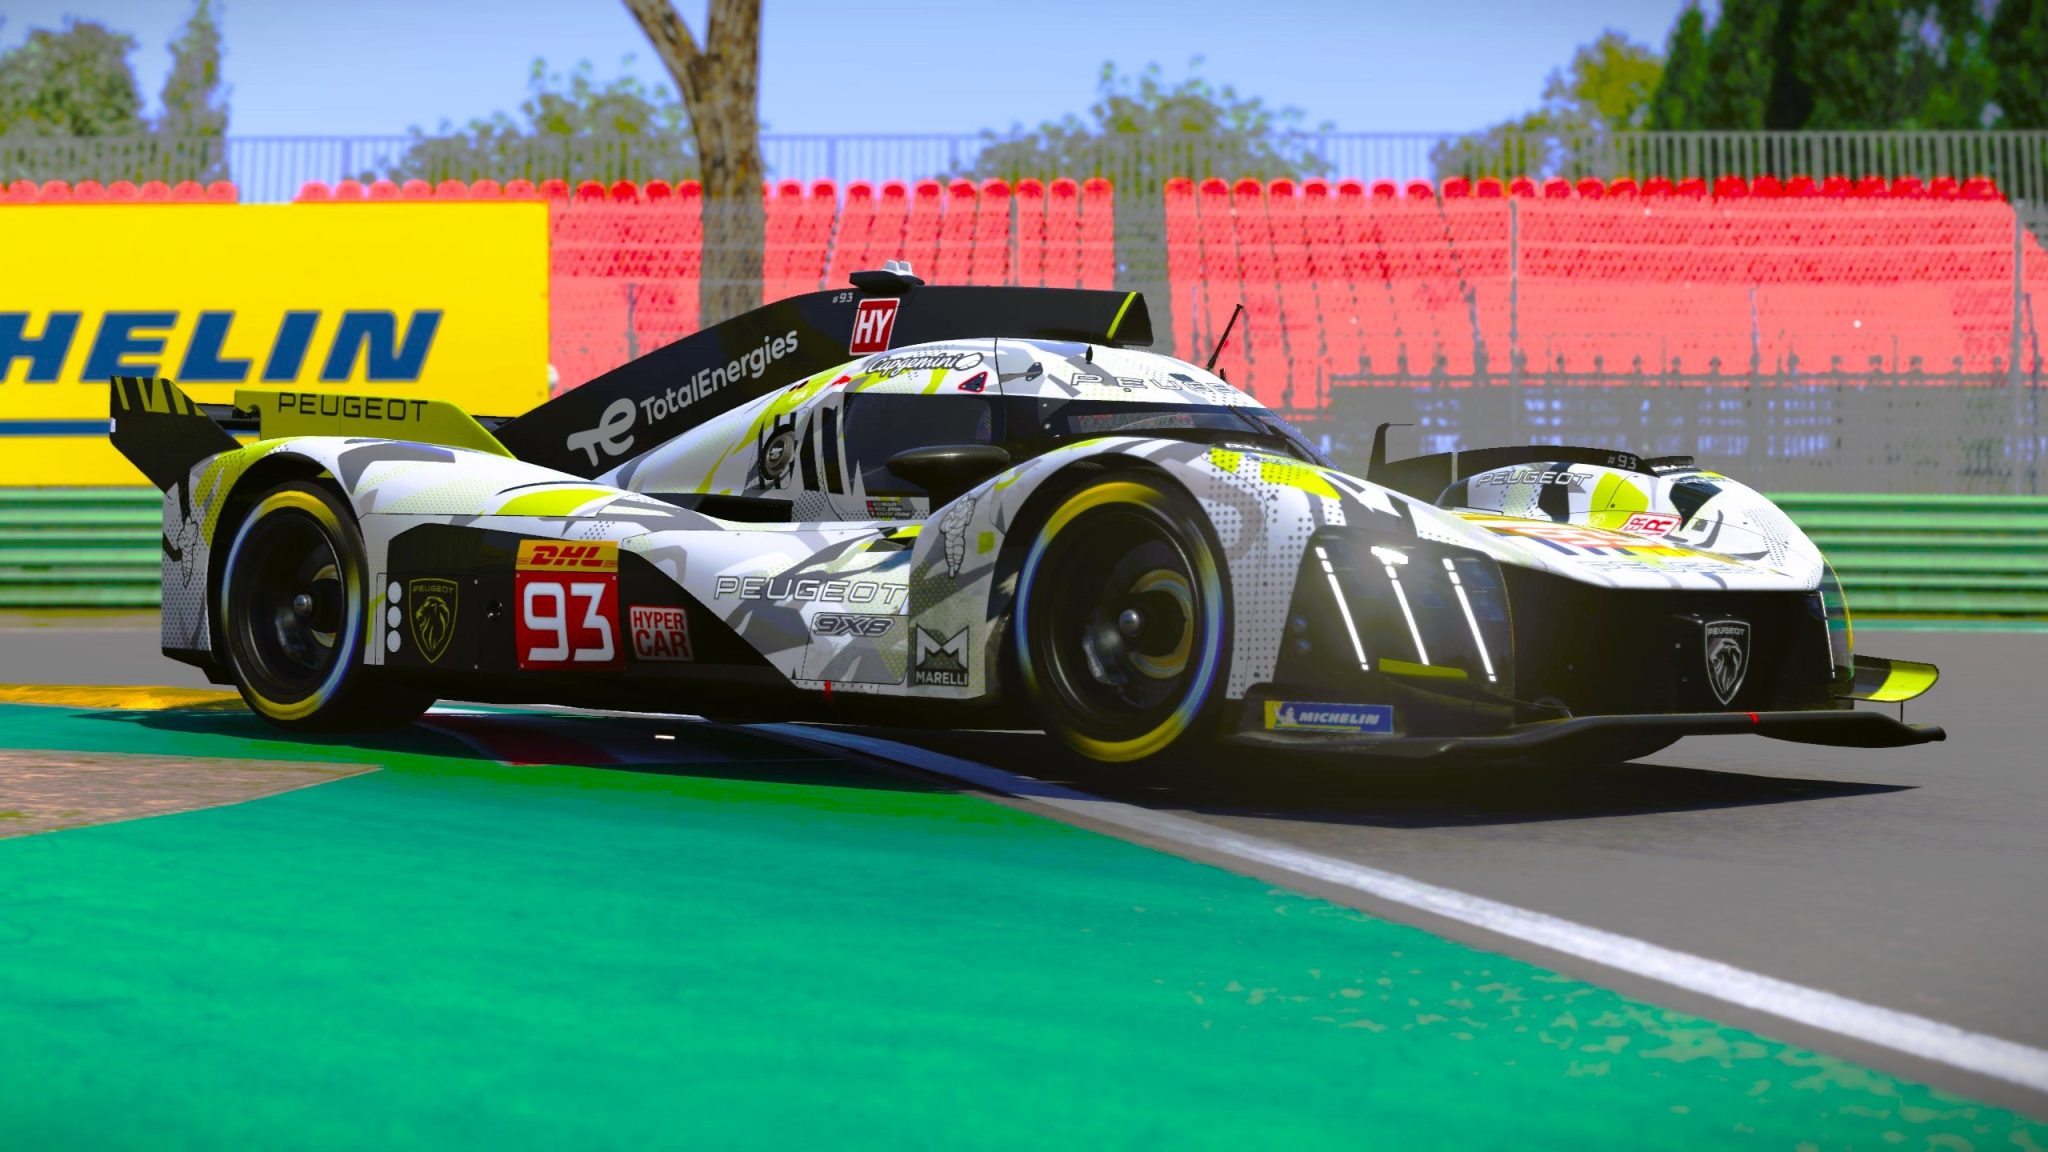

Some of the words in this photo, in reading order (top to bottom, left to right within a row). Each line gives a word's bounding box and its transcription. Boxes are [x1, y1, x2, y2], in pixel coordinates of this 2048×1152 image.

[854, 308, 894, 345] HY
[866, 352, 958, 378] Capgemini
[639, 329, 799, 426] TotalEnergies
[278, 391, 429, 423] PEUGEOT
[1476, 469, 1594, 488] PEUGEOT
[530, 545, 605, 566] DHL
[413, 584, 455, 594] PEUGEOT
[714, 575, 908, 605] PEUGEOT
[523, 581, 615, 662] 93
[632, 610, 685, 630] HYPER
[812, 613, 895, 637] 9X8
[1707, 626, 1746, 636] PEUGEOT
[634, 628, 691, 659] CAR
[915, 671, 969, 686] MARELLI
[1299, 711, 1380, 725] MICHELIN
